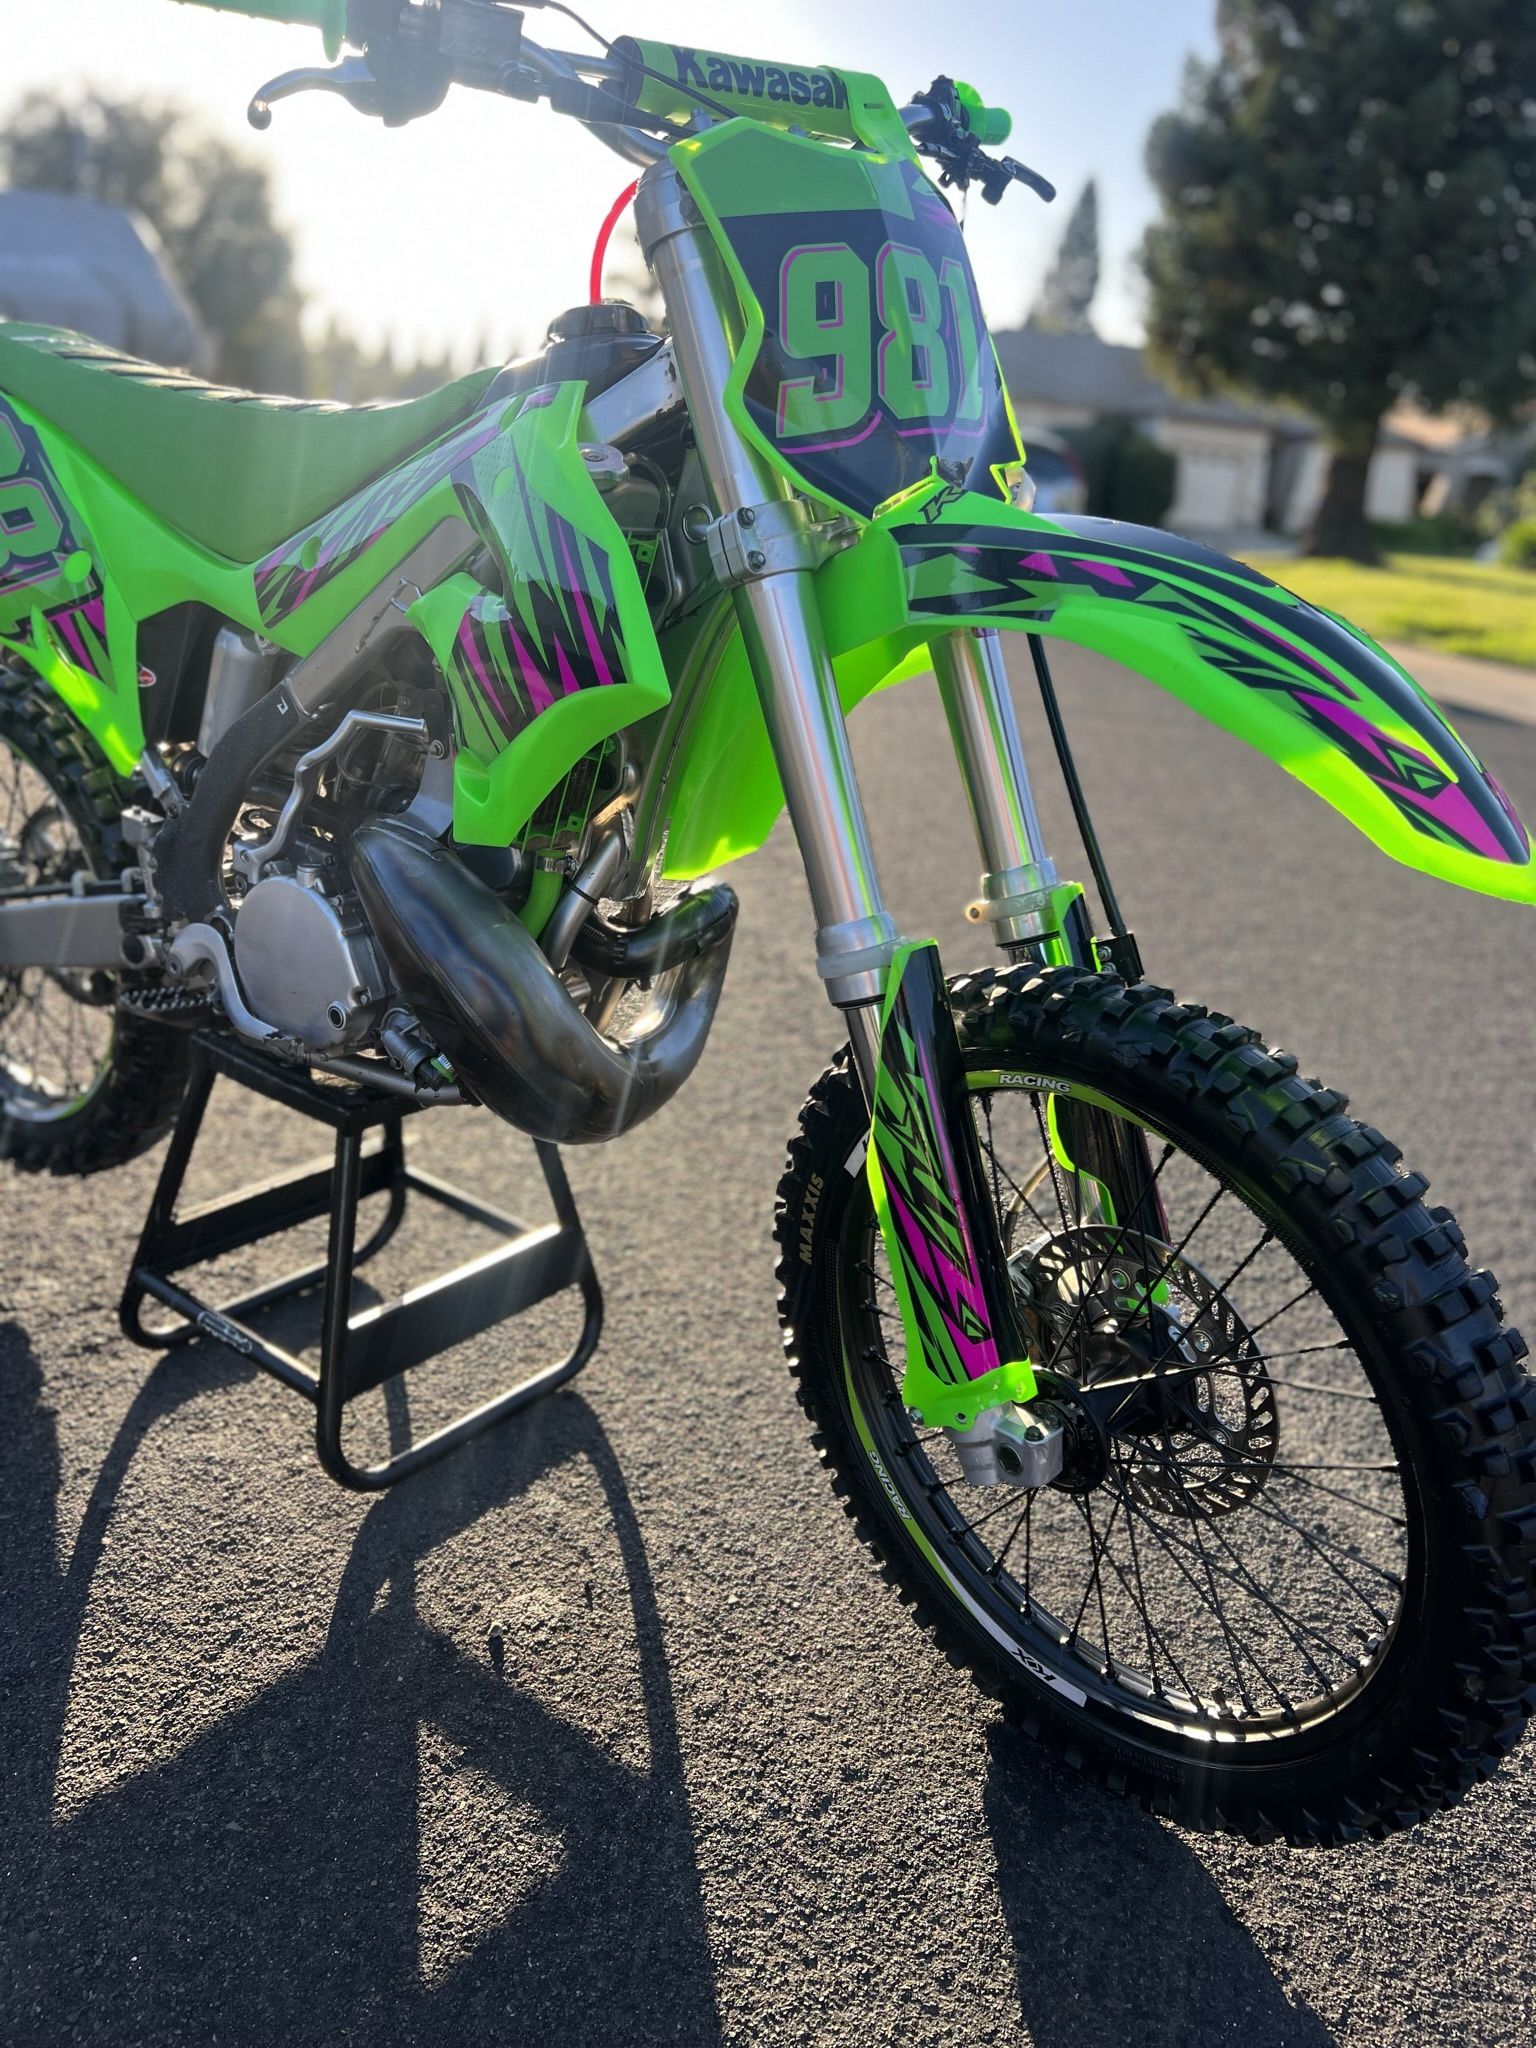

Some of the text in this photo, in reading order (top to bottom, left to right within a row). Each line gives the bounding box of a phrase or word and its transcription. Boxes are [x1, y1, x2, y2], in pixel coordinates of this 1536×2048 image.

[668, 45, 850, 110] Kawasak
[776, 240, 984, 439] 981
[999, 1074, 1071, 1093] RACING
[799, 1172, 824, 1265] MAXXIS
[869, 1450, 911, 1520] RACING
